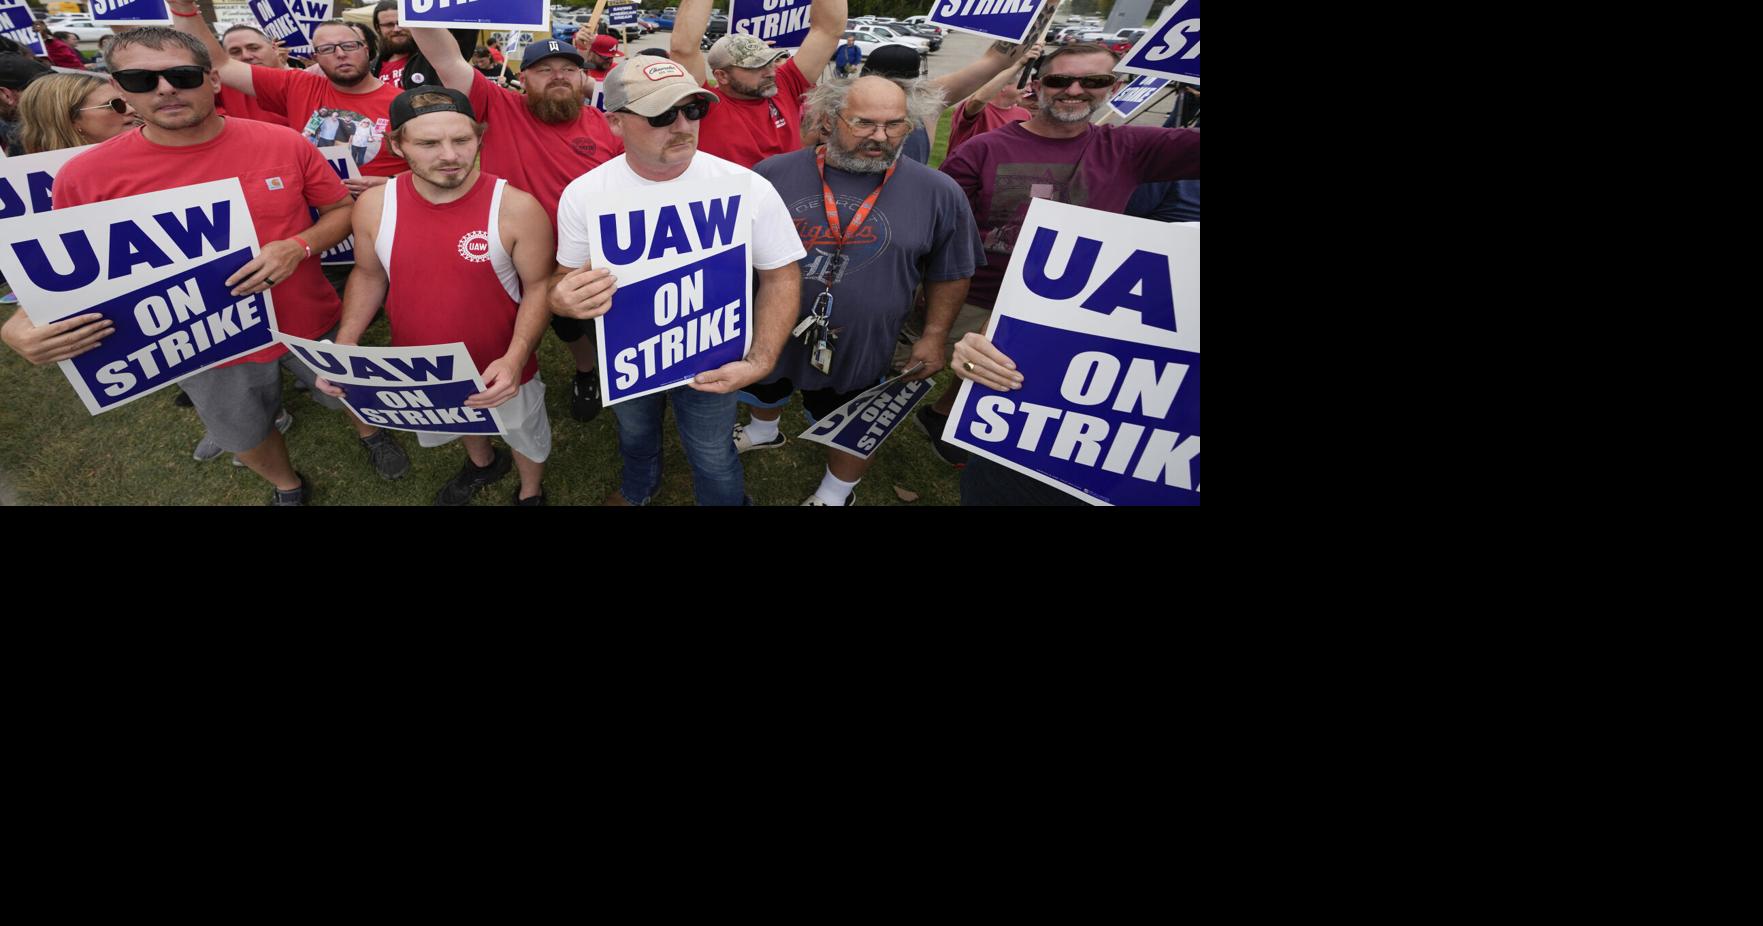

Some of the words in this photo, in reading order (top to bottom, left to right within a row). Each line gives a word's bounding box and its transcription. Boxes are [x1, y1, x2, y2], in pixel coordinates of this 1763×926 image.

[287, 0, 328, 19] AW
[10, 200, 231, 293] UAW
[469, 242, 488, 251] UAW
[599, 194, 741, 266] UAW
[133, 277, 206, 337] ON
[653, 269, 704, 327] ON
[1022, 226, 1178, 333] UA
[95, 295, 261, 397] STRIKE
[290, 343, 454, 382] UAW
[613, 299, 741, 391] STRIKE
[359, 406, 487, 425] STRIKE
[375, 389, 434, 409] ON
[857, 380, 923, 451] STRIKE
[860, 392, 893, 423] ON
[1060, 350, 1190, 419] ON
[969, 395, 1200, 492] STRIK
